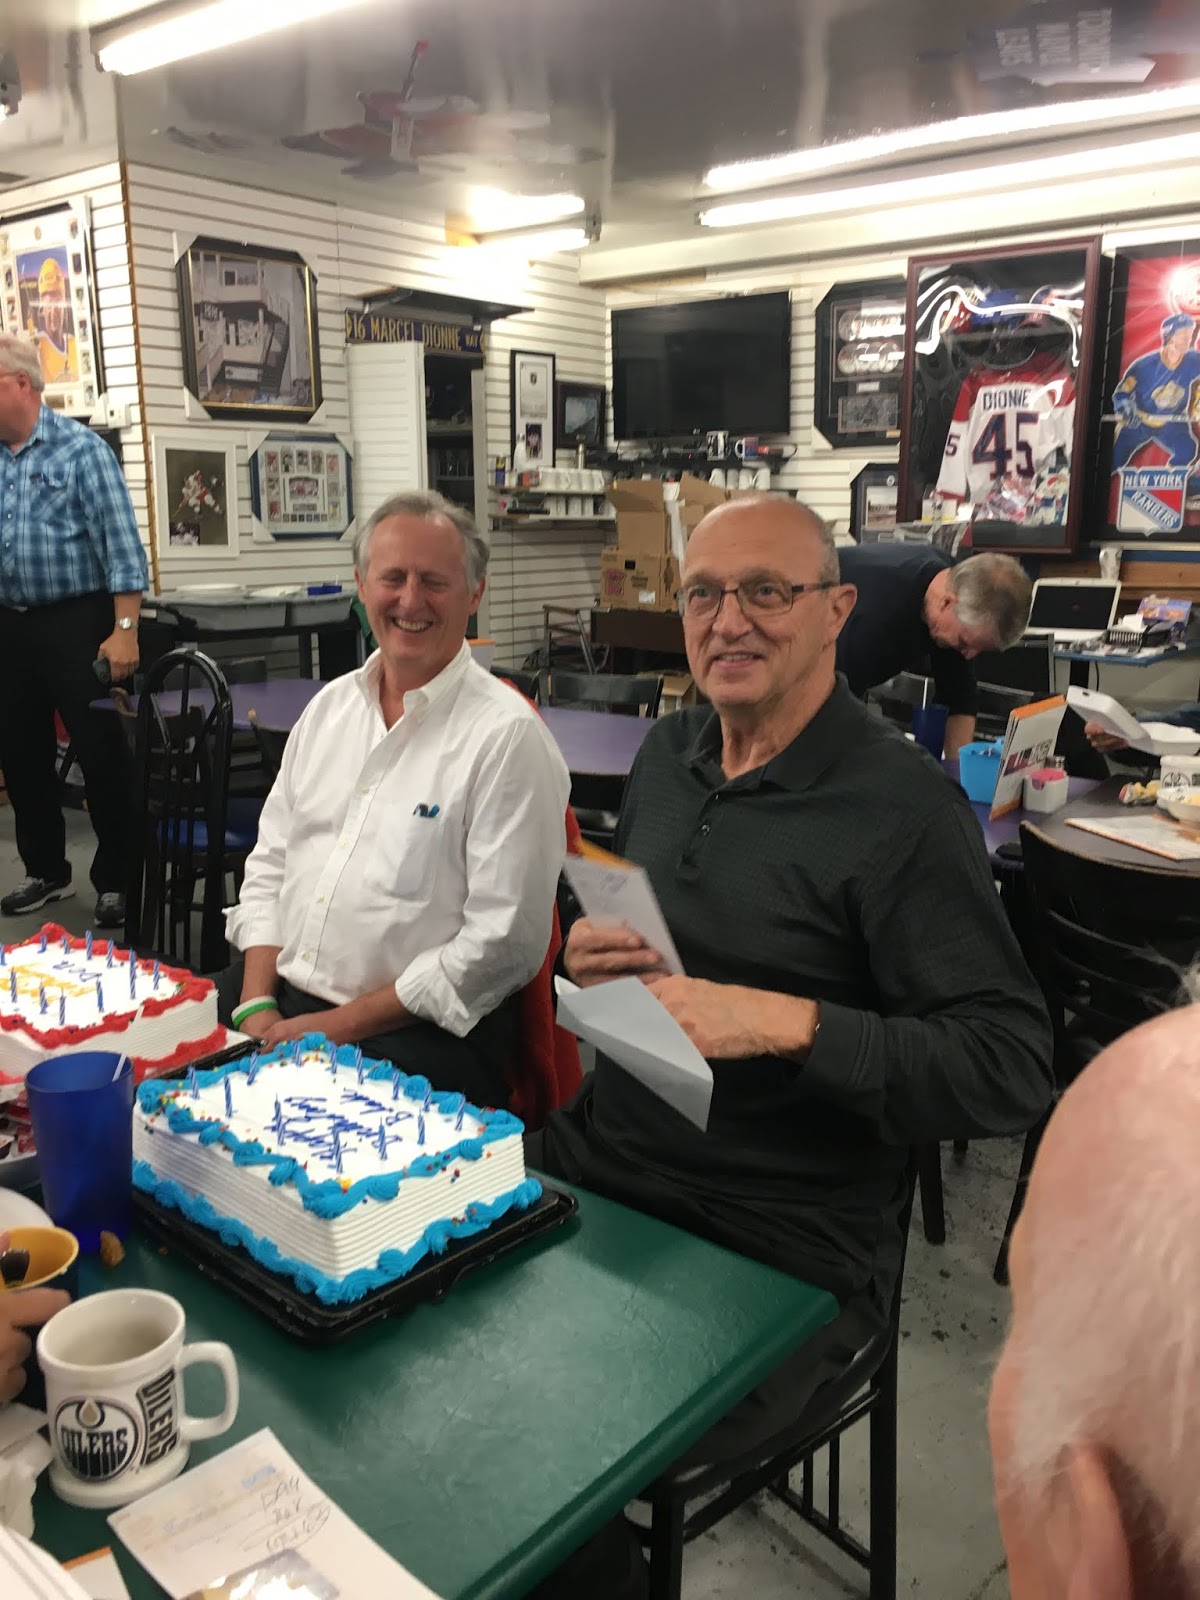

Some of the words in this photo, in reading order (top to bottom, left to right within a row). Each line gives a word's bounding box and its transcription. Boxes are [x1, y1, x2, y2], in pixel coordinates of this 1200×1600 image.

[422, 323, 463, 351] DIONNE
[465, 334, 480, 348] WAY
[972, 412, 1038, 480] 45
[1125, 474, 1151, 487] NEW
[1153, 473, 1184, 487] YORK
[1131, 489, 1179, 529] RANGERS
[142, 1367, 178, 1466] OILERS
[61, 1424, 128, 1466] OILERS
